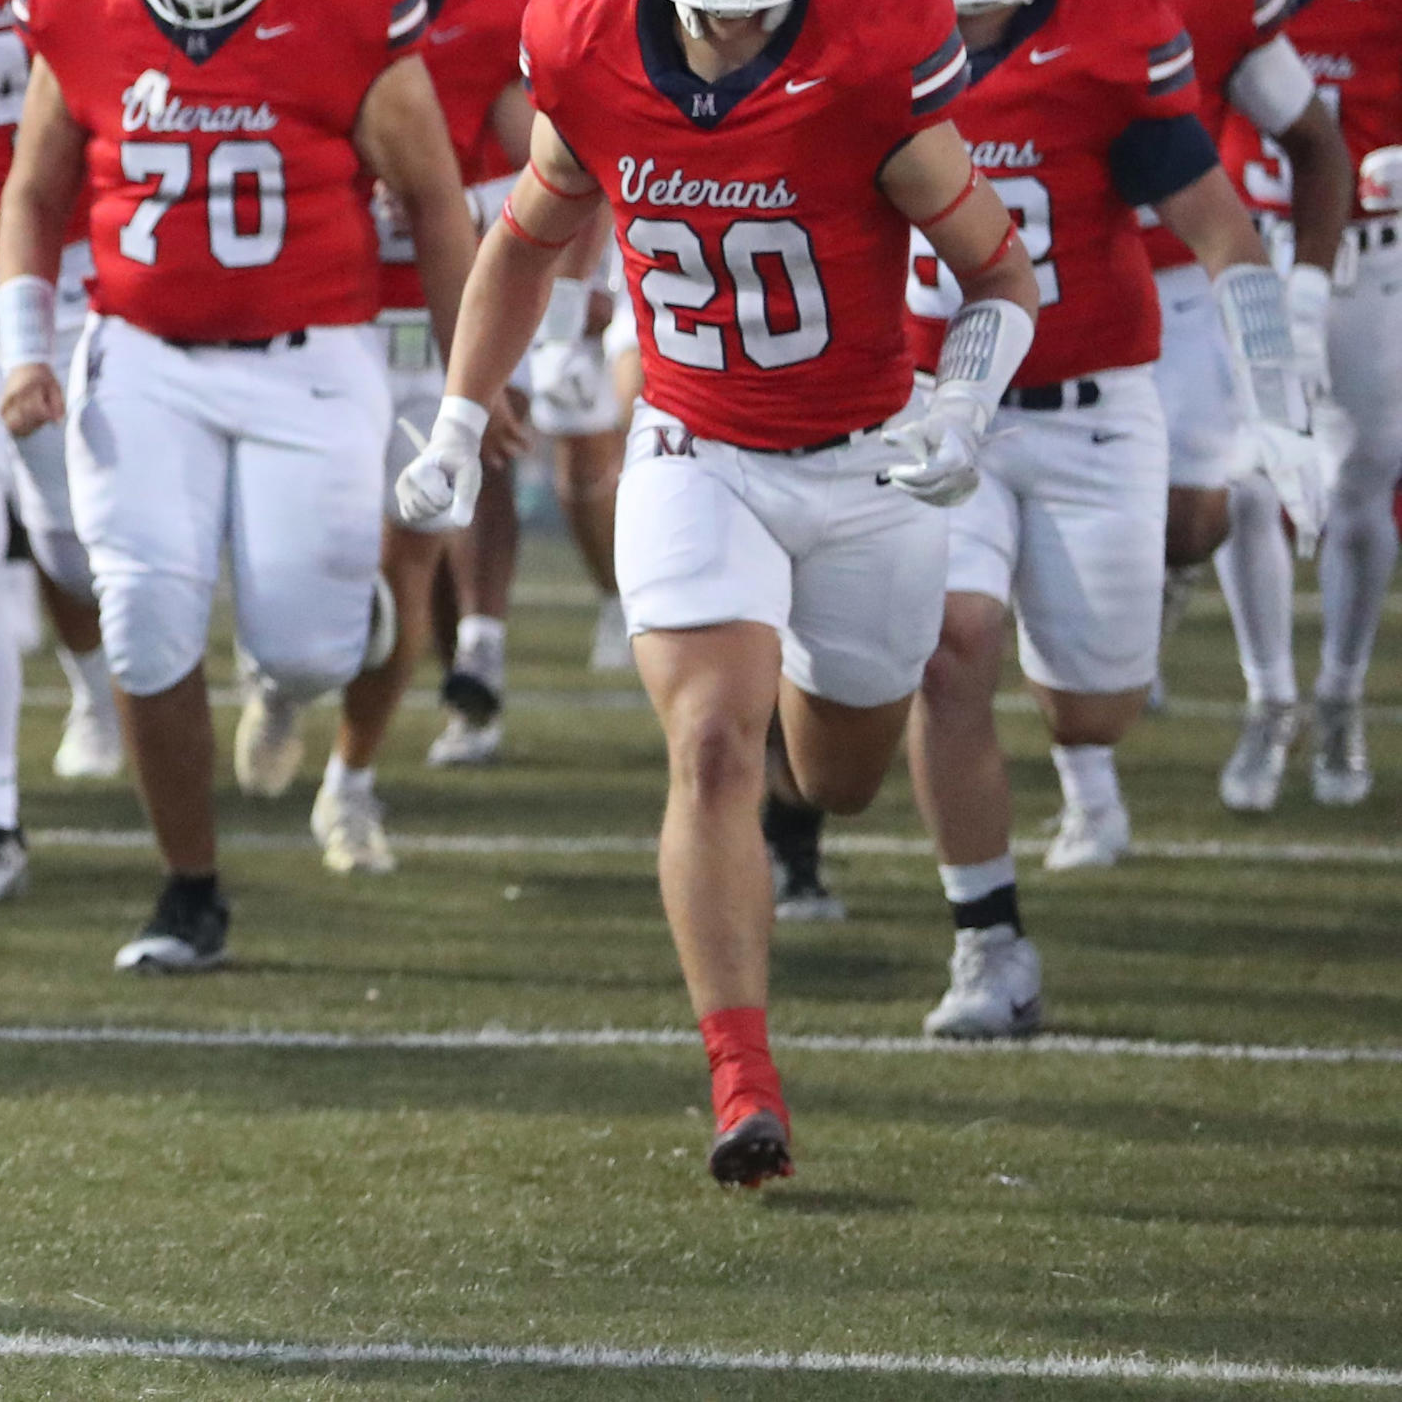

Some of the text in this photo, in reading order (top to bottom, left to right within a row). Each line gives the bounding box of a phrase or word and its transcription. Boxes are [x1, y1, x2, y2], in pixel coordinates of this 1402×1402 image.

[692, 93, 717, 117] M
[119, 140, 287, 269] 70
[618, 154, 797, 210] Veterans
[626, 215, 833, 372] 20
